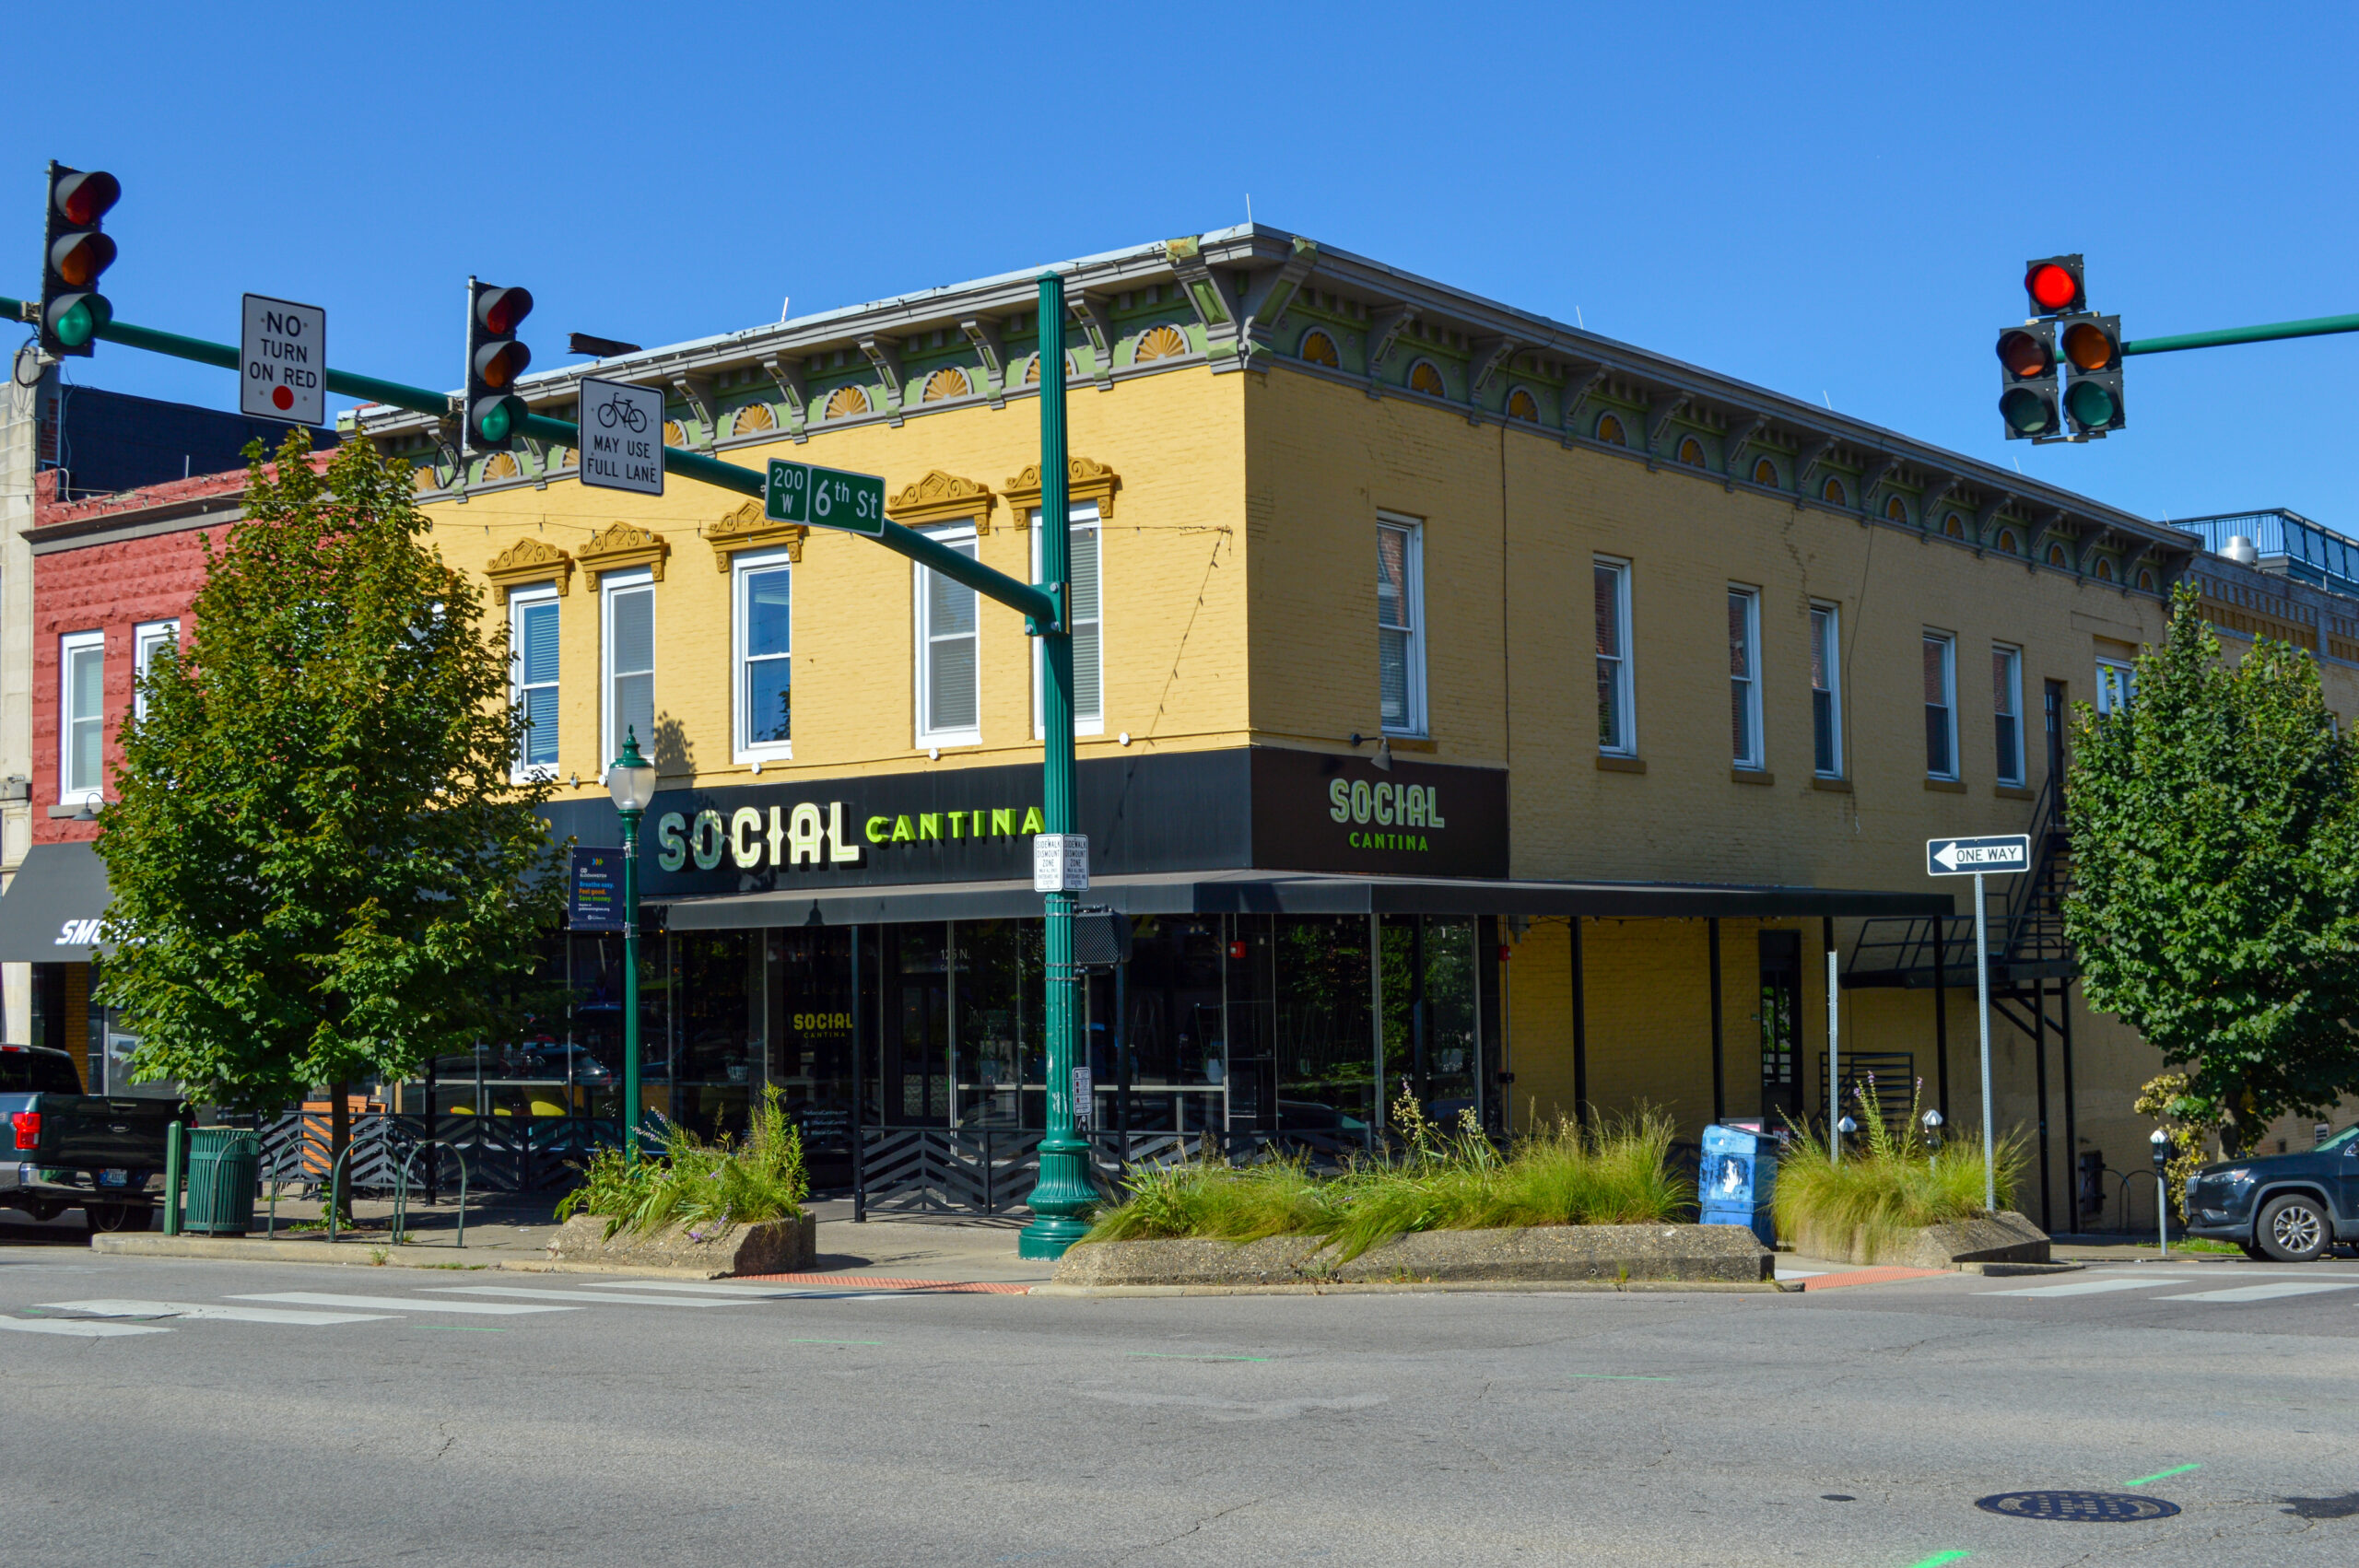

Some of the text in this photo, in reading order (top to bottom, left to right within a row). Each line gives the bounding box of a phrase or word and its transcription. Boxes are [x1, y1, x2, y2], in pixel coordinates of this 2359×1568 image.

[266, 310, 301, 337] NO
[261, 338, 308, 363] TURN
[249, 361, 317, 389] ON RED
[593, 434, 651, 459] MAY USE
[587, 458, 657, 484] FULL LANE
[774, 467, 804, 490] 200
[781, 493, 793, 514] W
[815, 479, 878, 519] 6th St
[1329, 778, 1445, 828] SOCIAL
[658, 802, 1045, 872] SOCIAL CANTINA
[1037, 840, 1061, 848] SIDEWALK
[1064, 840, 1086, 848] SIDEWALK
[1349, 832, 1428, 851] CANTINA
[1037, 849, 1060, 859] DISMOUNT
[1042, 859, 1054, 868] ZONE
[1065, 849, 1086, 858] DISMOUNT
[1070, 859, 1081, 867] ZONE
[1956, 847, 2017, 862] ONE WAY
[793, 1013, 853, 1030] SOCIAL
